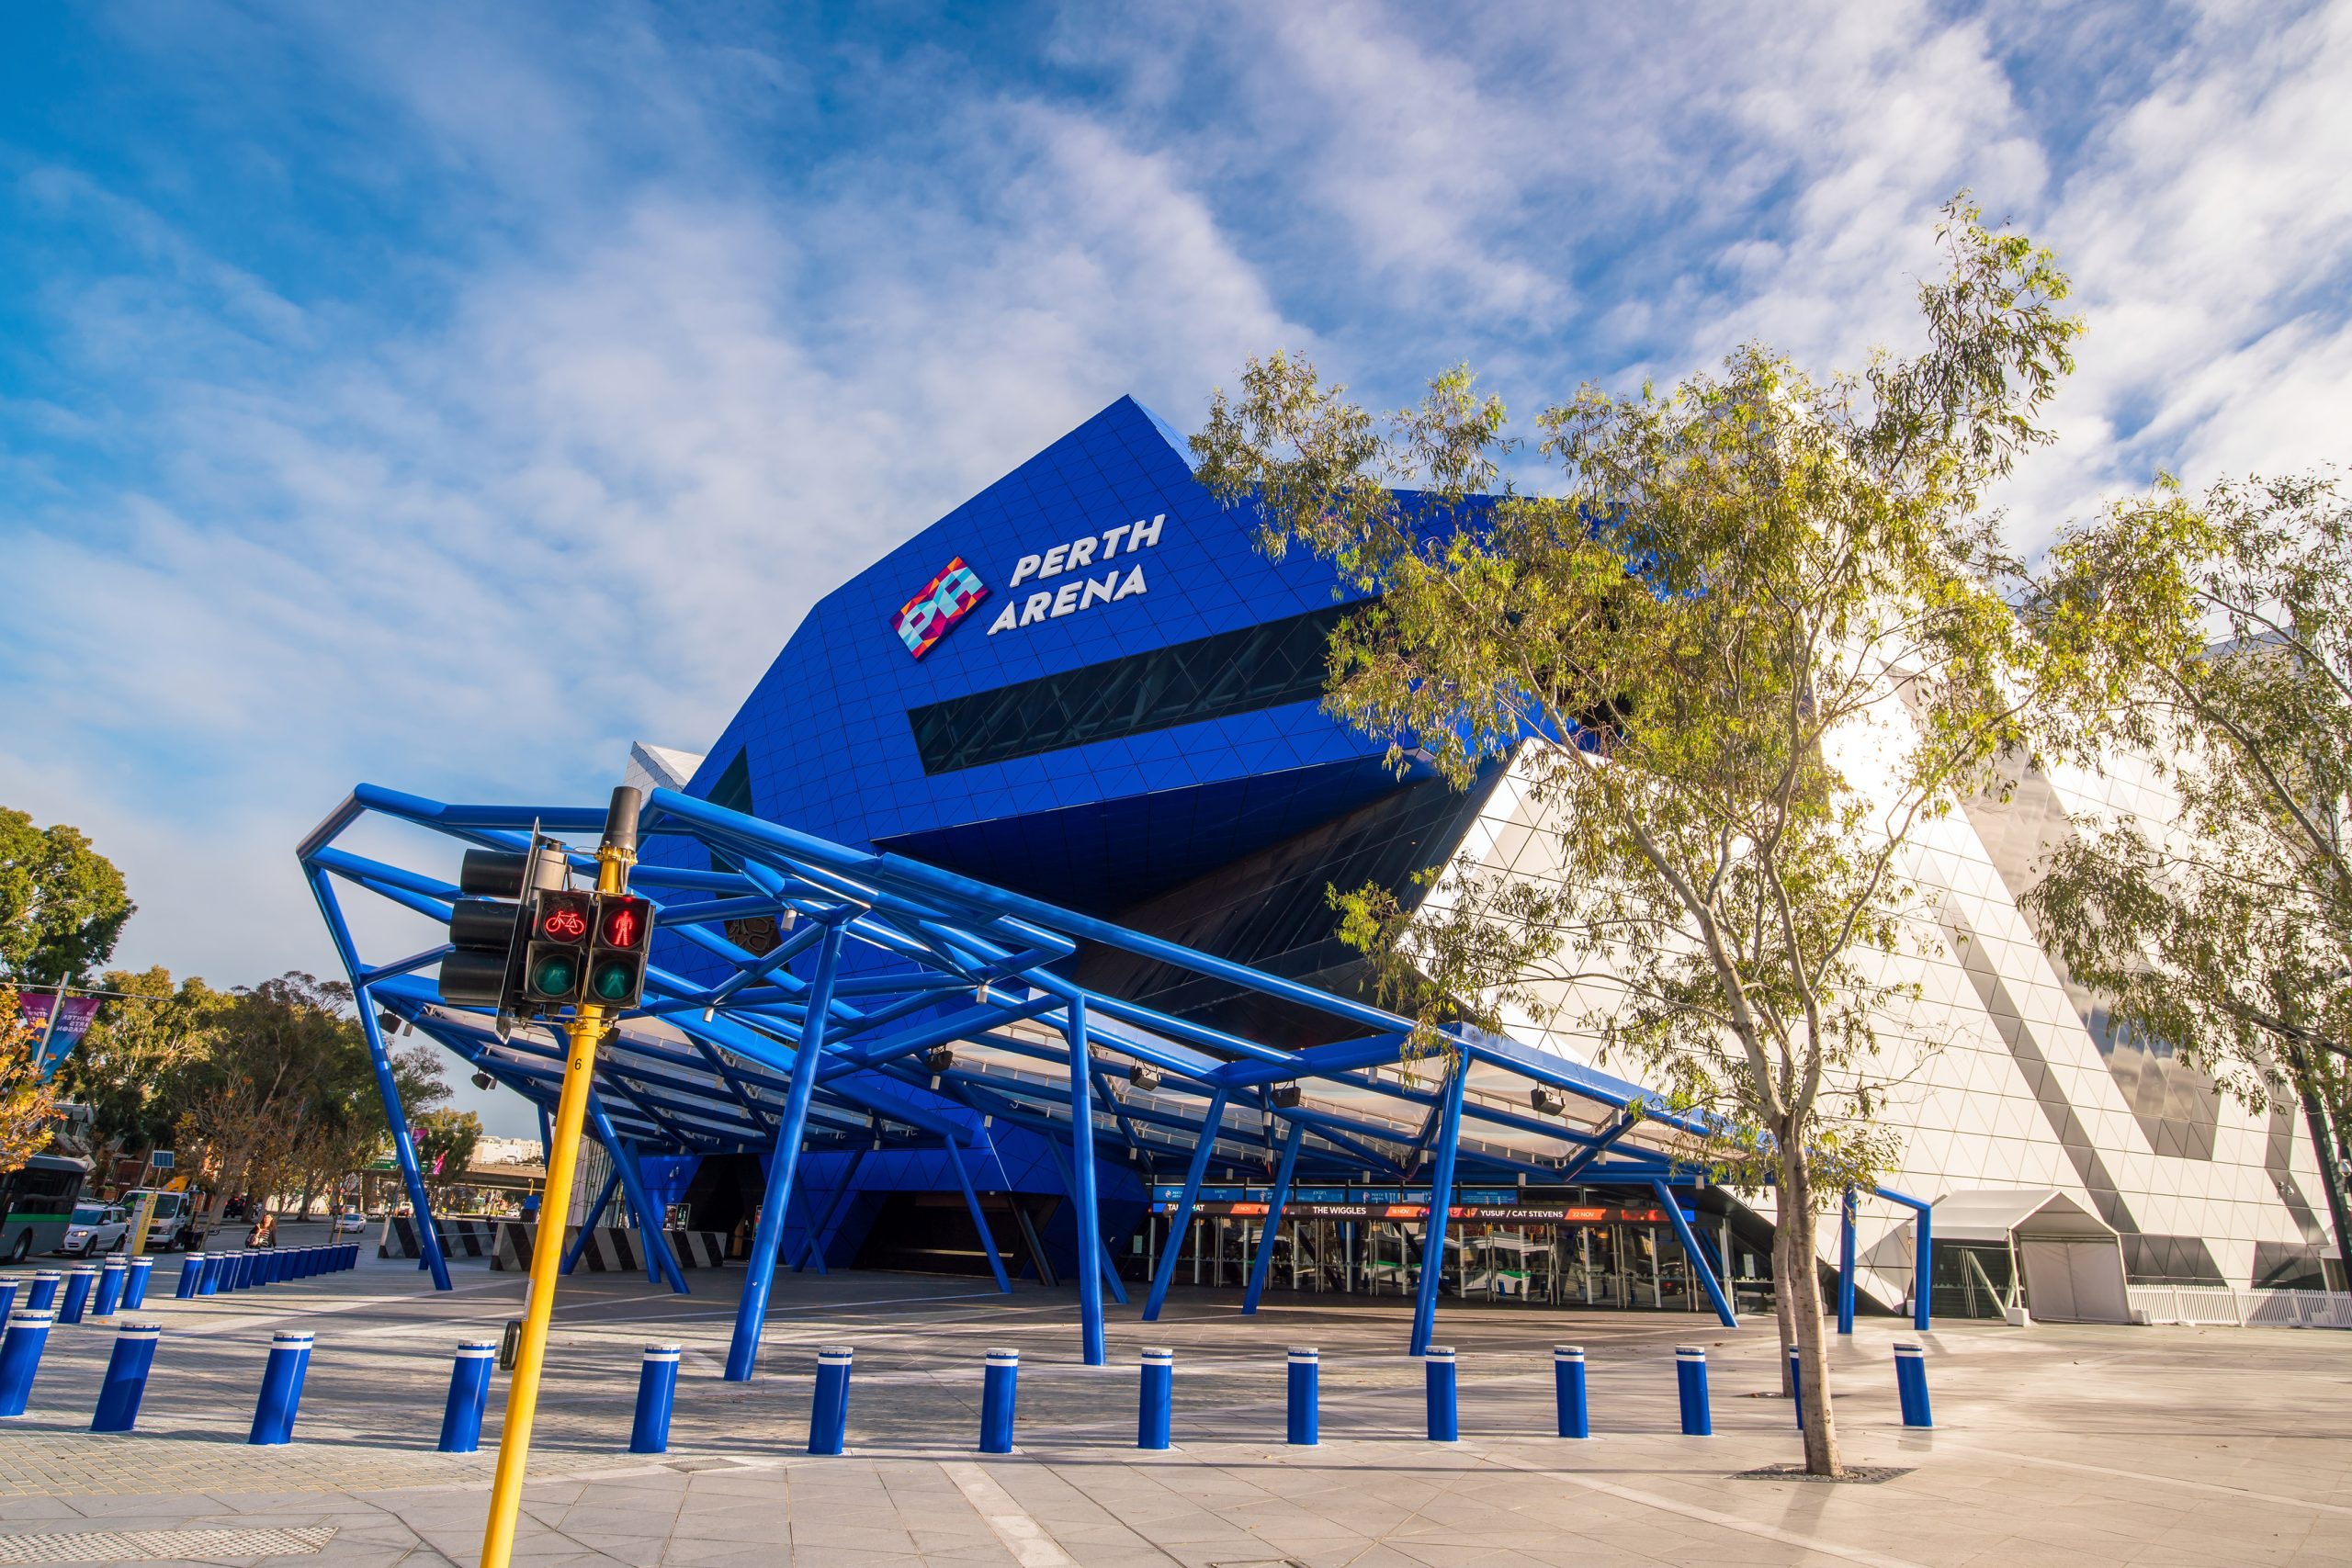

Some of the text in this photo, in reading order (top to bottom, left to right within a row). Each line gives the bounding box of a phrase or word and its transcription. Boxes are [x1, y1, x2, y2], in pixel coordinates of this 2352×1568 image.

[1009, 513, 1166, 588] PERTH
[987, 564, 1148, 636] ARENA
[574, 1057, 582, 1070] 6
[1506, 1210, 1511, 1218] /
